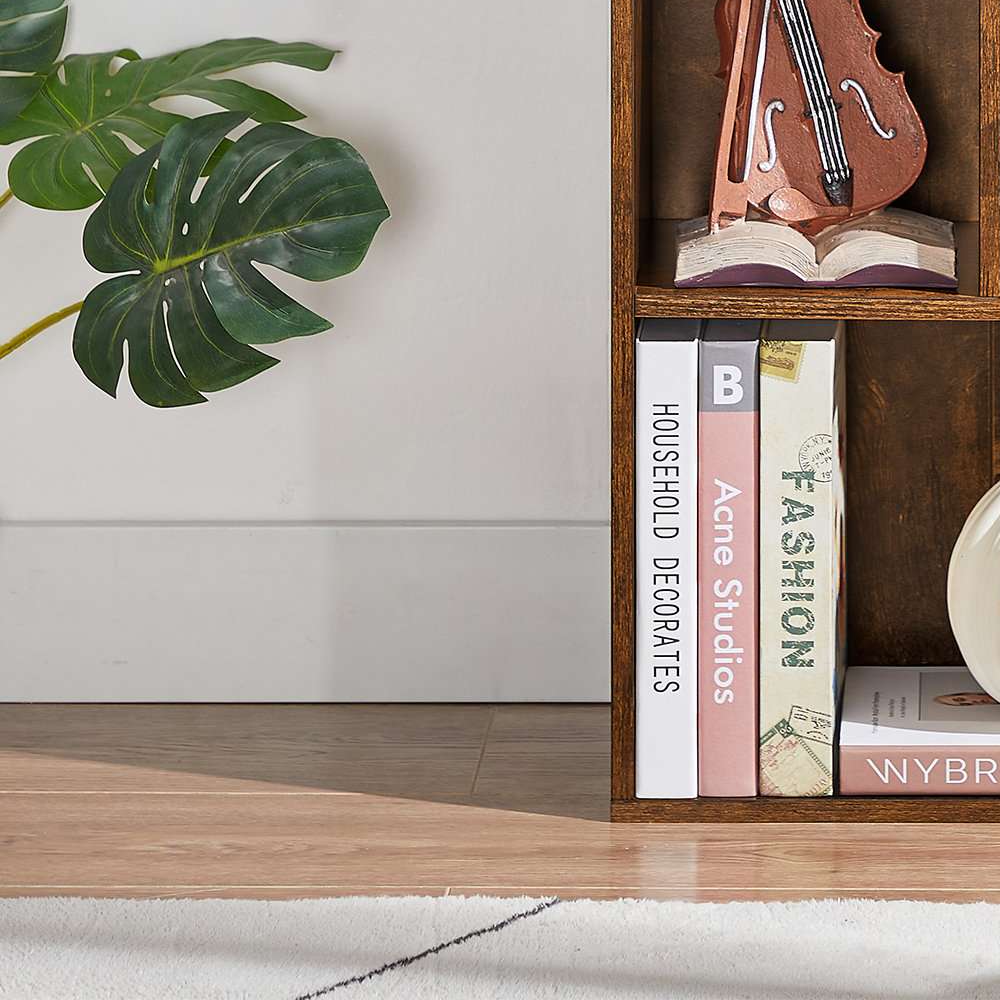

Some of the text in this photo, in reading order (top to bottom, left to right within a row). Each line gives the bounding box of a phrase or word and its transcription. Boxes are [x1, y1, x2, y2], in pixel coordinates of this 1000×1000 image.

[713, 365, 744, 405] B
[652, 403, 680, 693] HOUSEHOLD DECORATES
[713, 478, 744, 705] Acne Studios
[781, 470, 816, 668] FASHION
